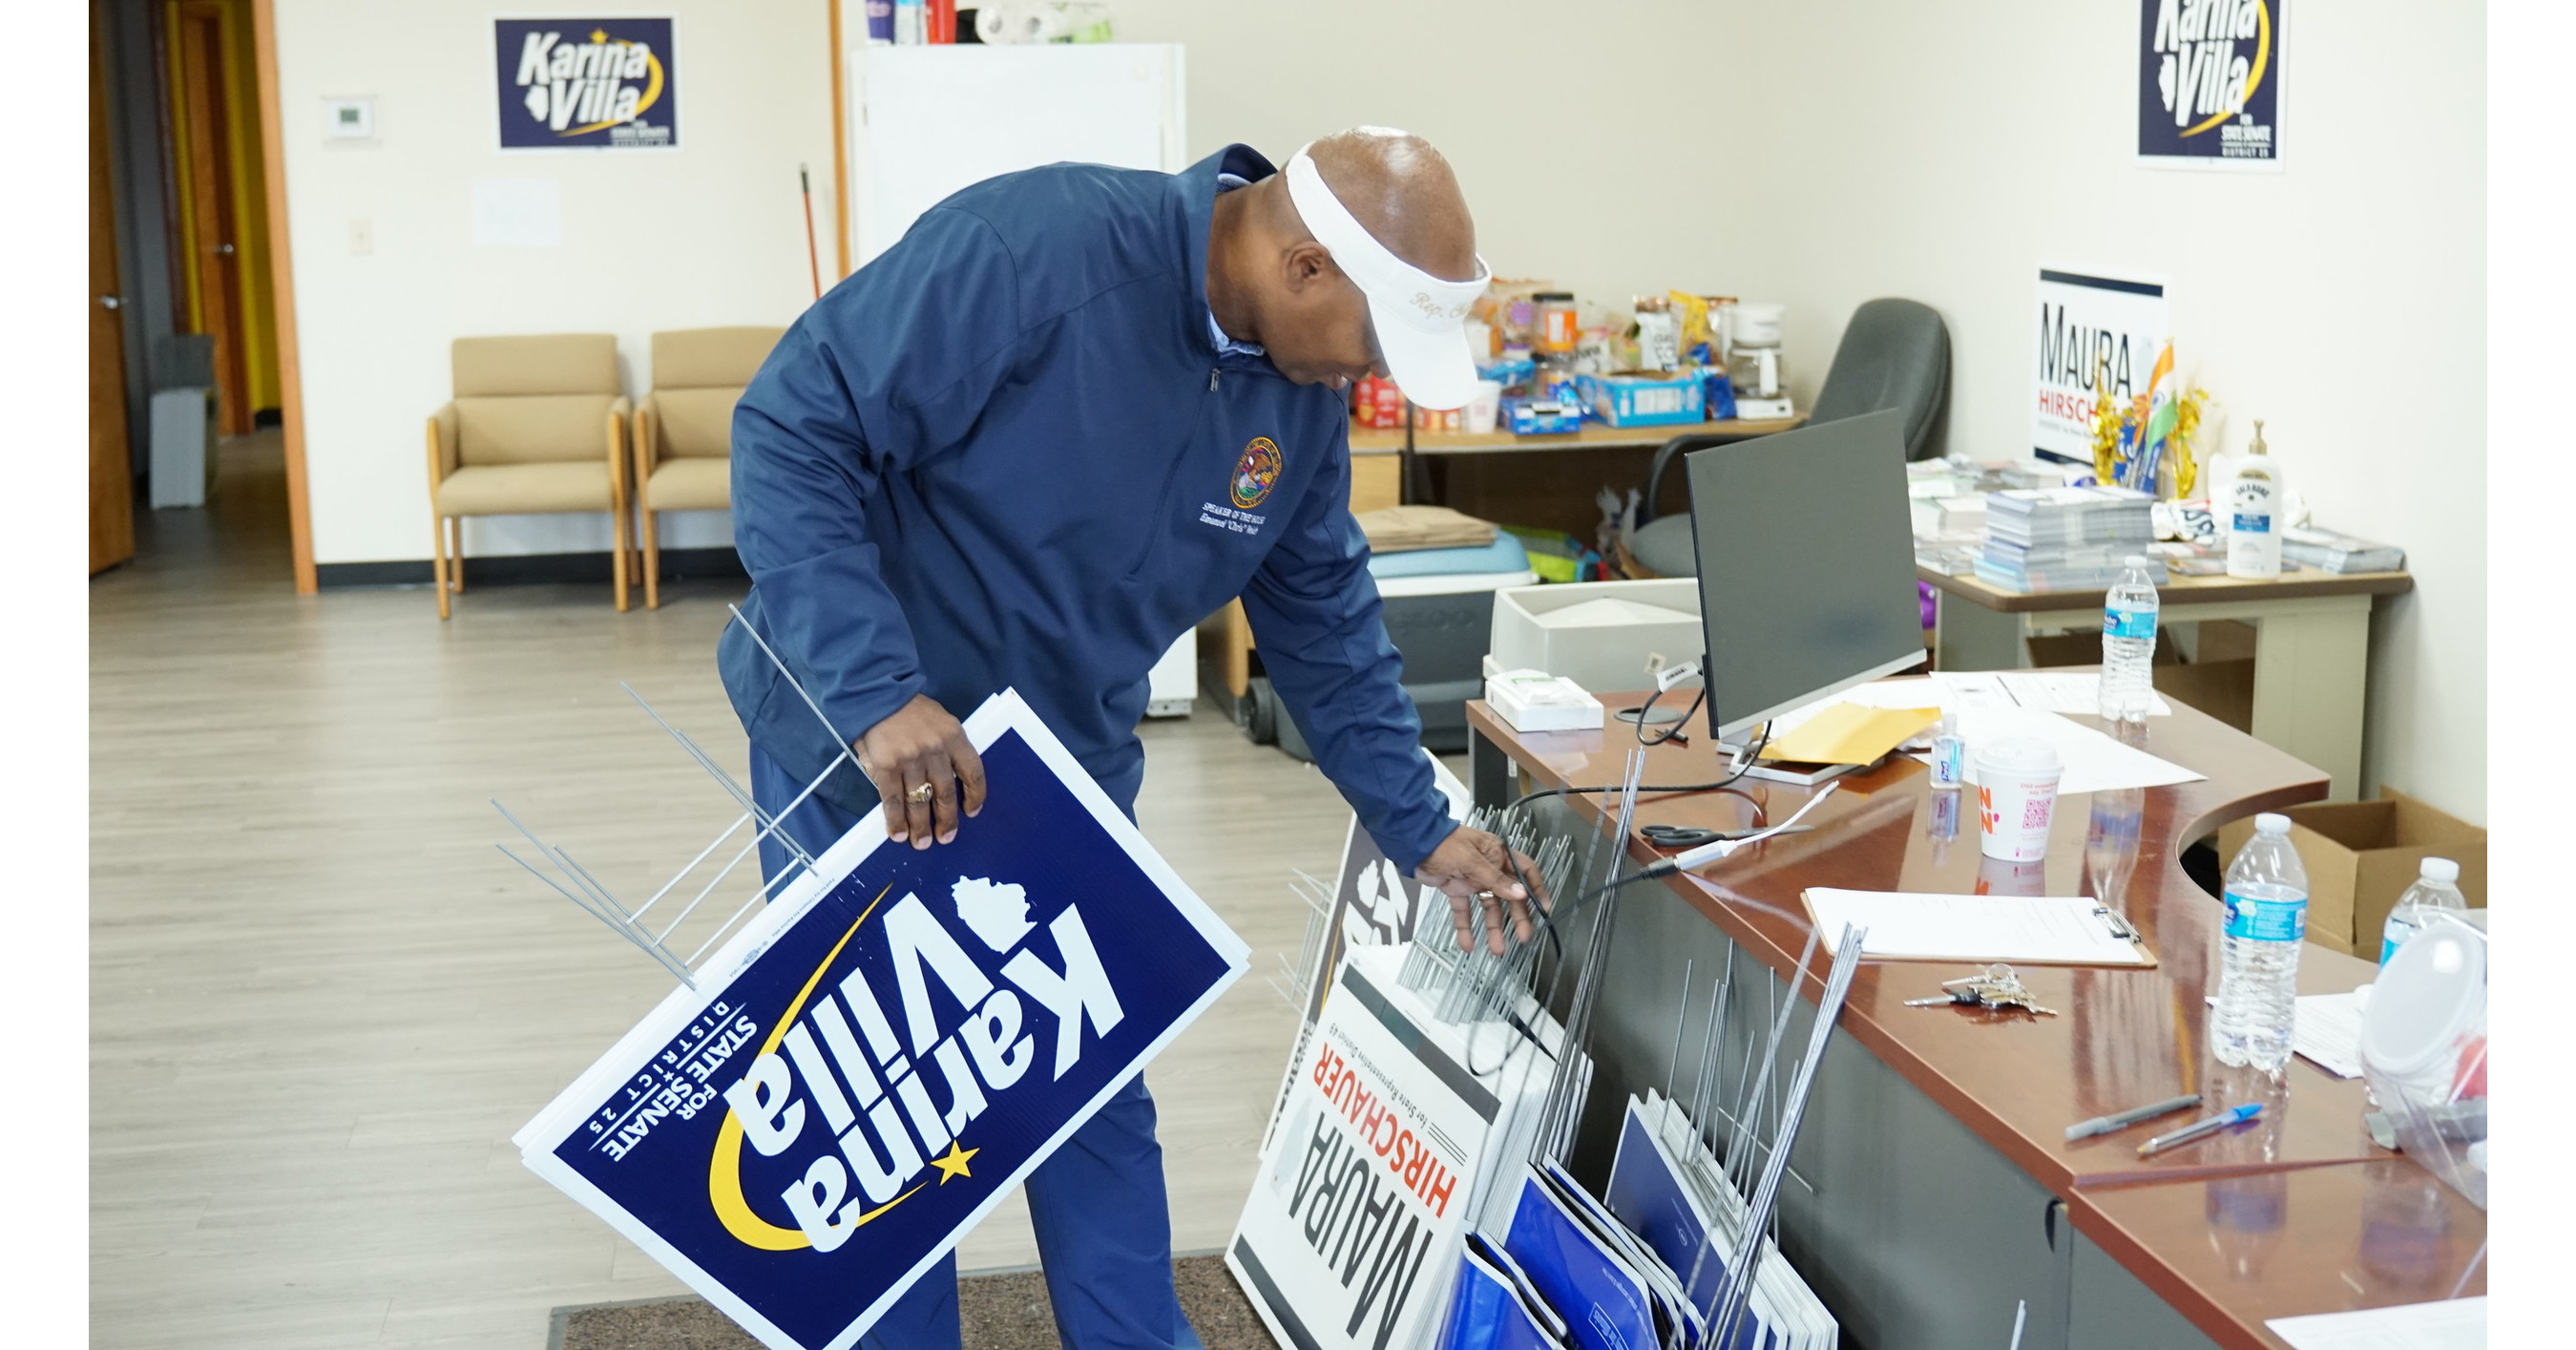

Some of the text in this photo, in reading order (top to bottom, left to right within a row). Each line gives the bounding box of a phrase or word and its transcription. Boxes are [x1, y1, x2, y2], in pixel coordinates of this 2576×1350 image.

[515, 32, 651, 86] Karina
[549, 78, 640, 131] Villa
[2175, 39, 2250, 127] Villa
[2040, 302, 2132, 399] MAURA
[589, 1001, 730, 1134] DISTRICT 25
[723, 892, 994, 1156] Villa
[782, 903, 1124, 1253] Karina
[1328, 1022, 1428, 1129] for State Representative District 49
[601, 1015, 758, 1162] STATE SENATE
[676, 1083, 718, 1121] FOR
[1313, 1042, 1456, 1218] HIRSCHAUER
[1288, 1111, 1434, 1350] MAURA
